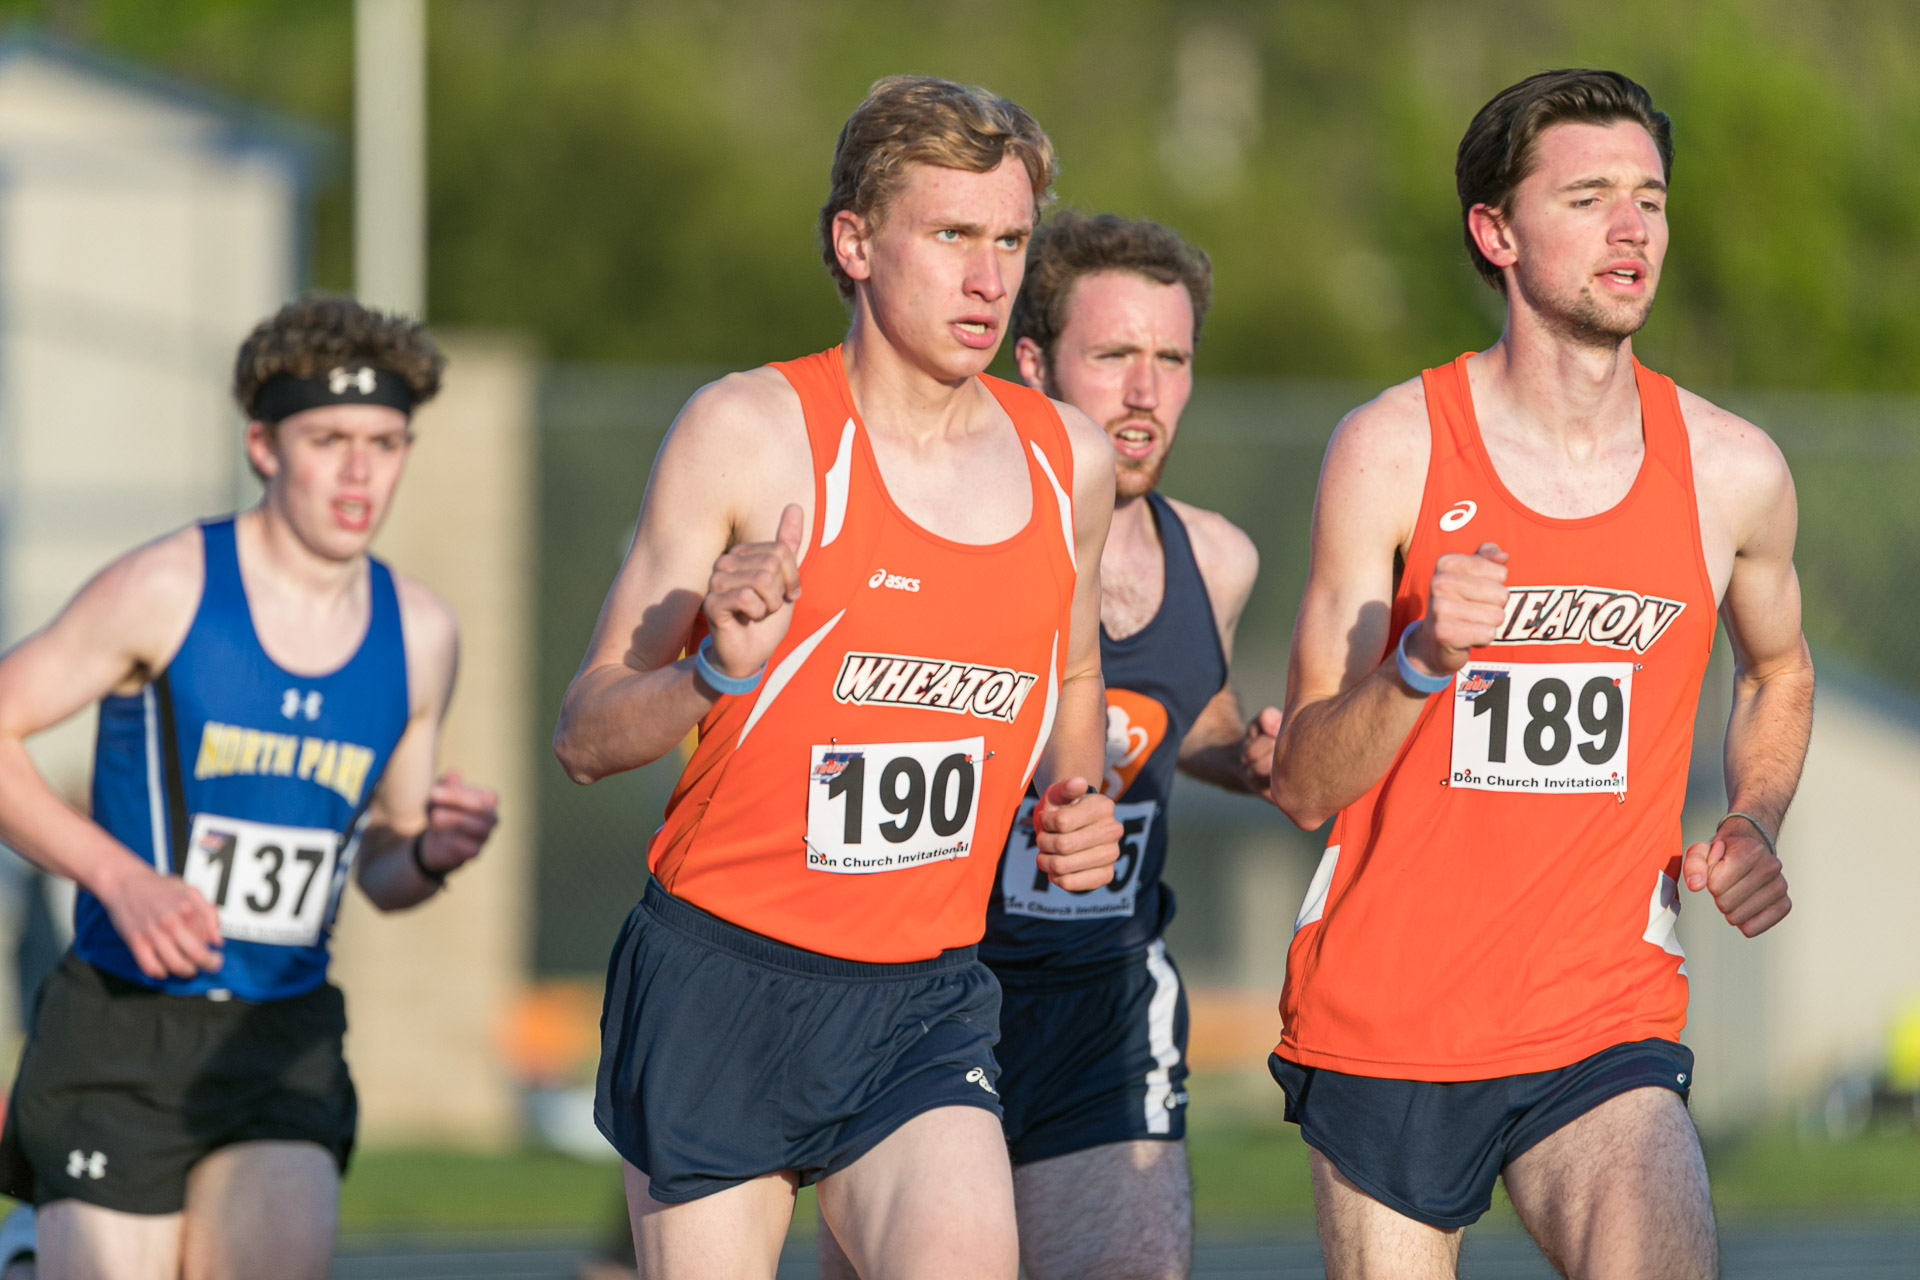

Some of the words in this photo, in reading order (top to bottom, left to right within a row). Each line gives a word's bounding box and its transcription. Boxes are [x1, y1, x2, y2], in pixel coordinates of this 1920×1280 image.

[884, 573, 921, 593] asics
[1490, 585, 1688, 655] EATON
[833, 651, 1039, 724] WHEATON
[1473, 676, 1624, 767] 189
[194, 719, 299, 781] NORTH
[1453, 772, 1482, 785] Don
[1486, 775, 1539, 788] Church
[1544, 776, 1626, 789] Invitational
[828, 752, 975, 845] 190
[205, 832, 325, 918] 137
[809, 854, 837, 867] Don
[843, 855, 893, 868] Church
[898, 842, 969, 864] Invitational
